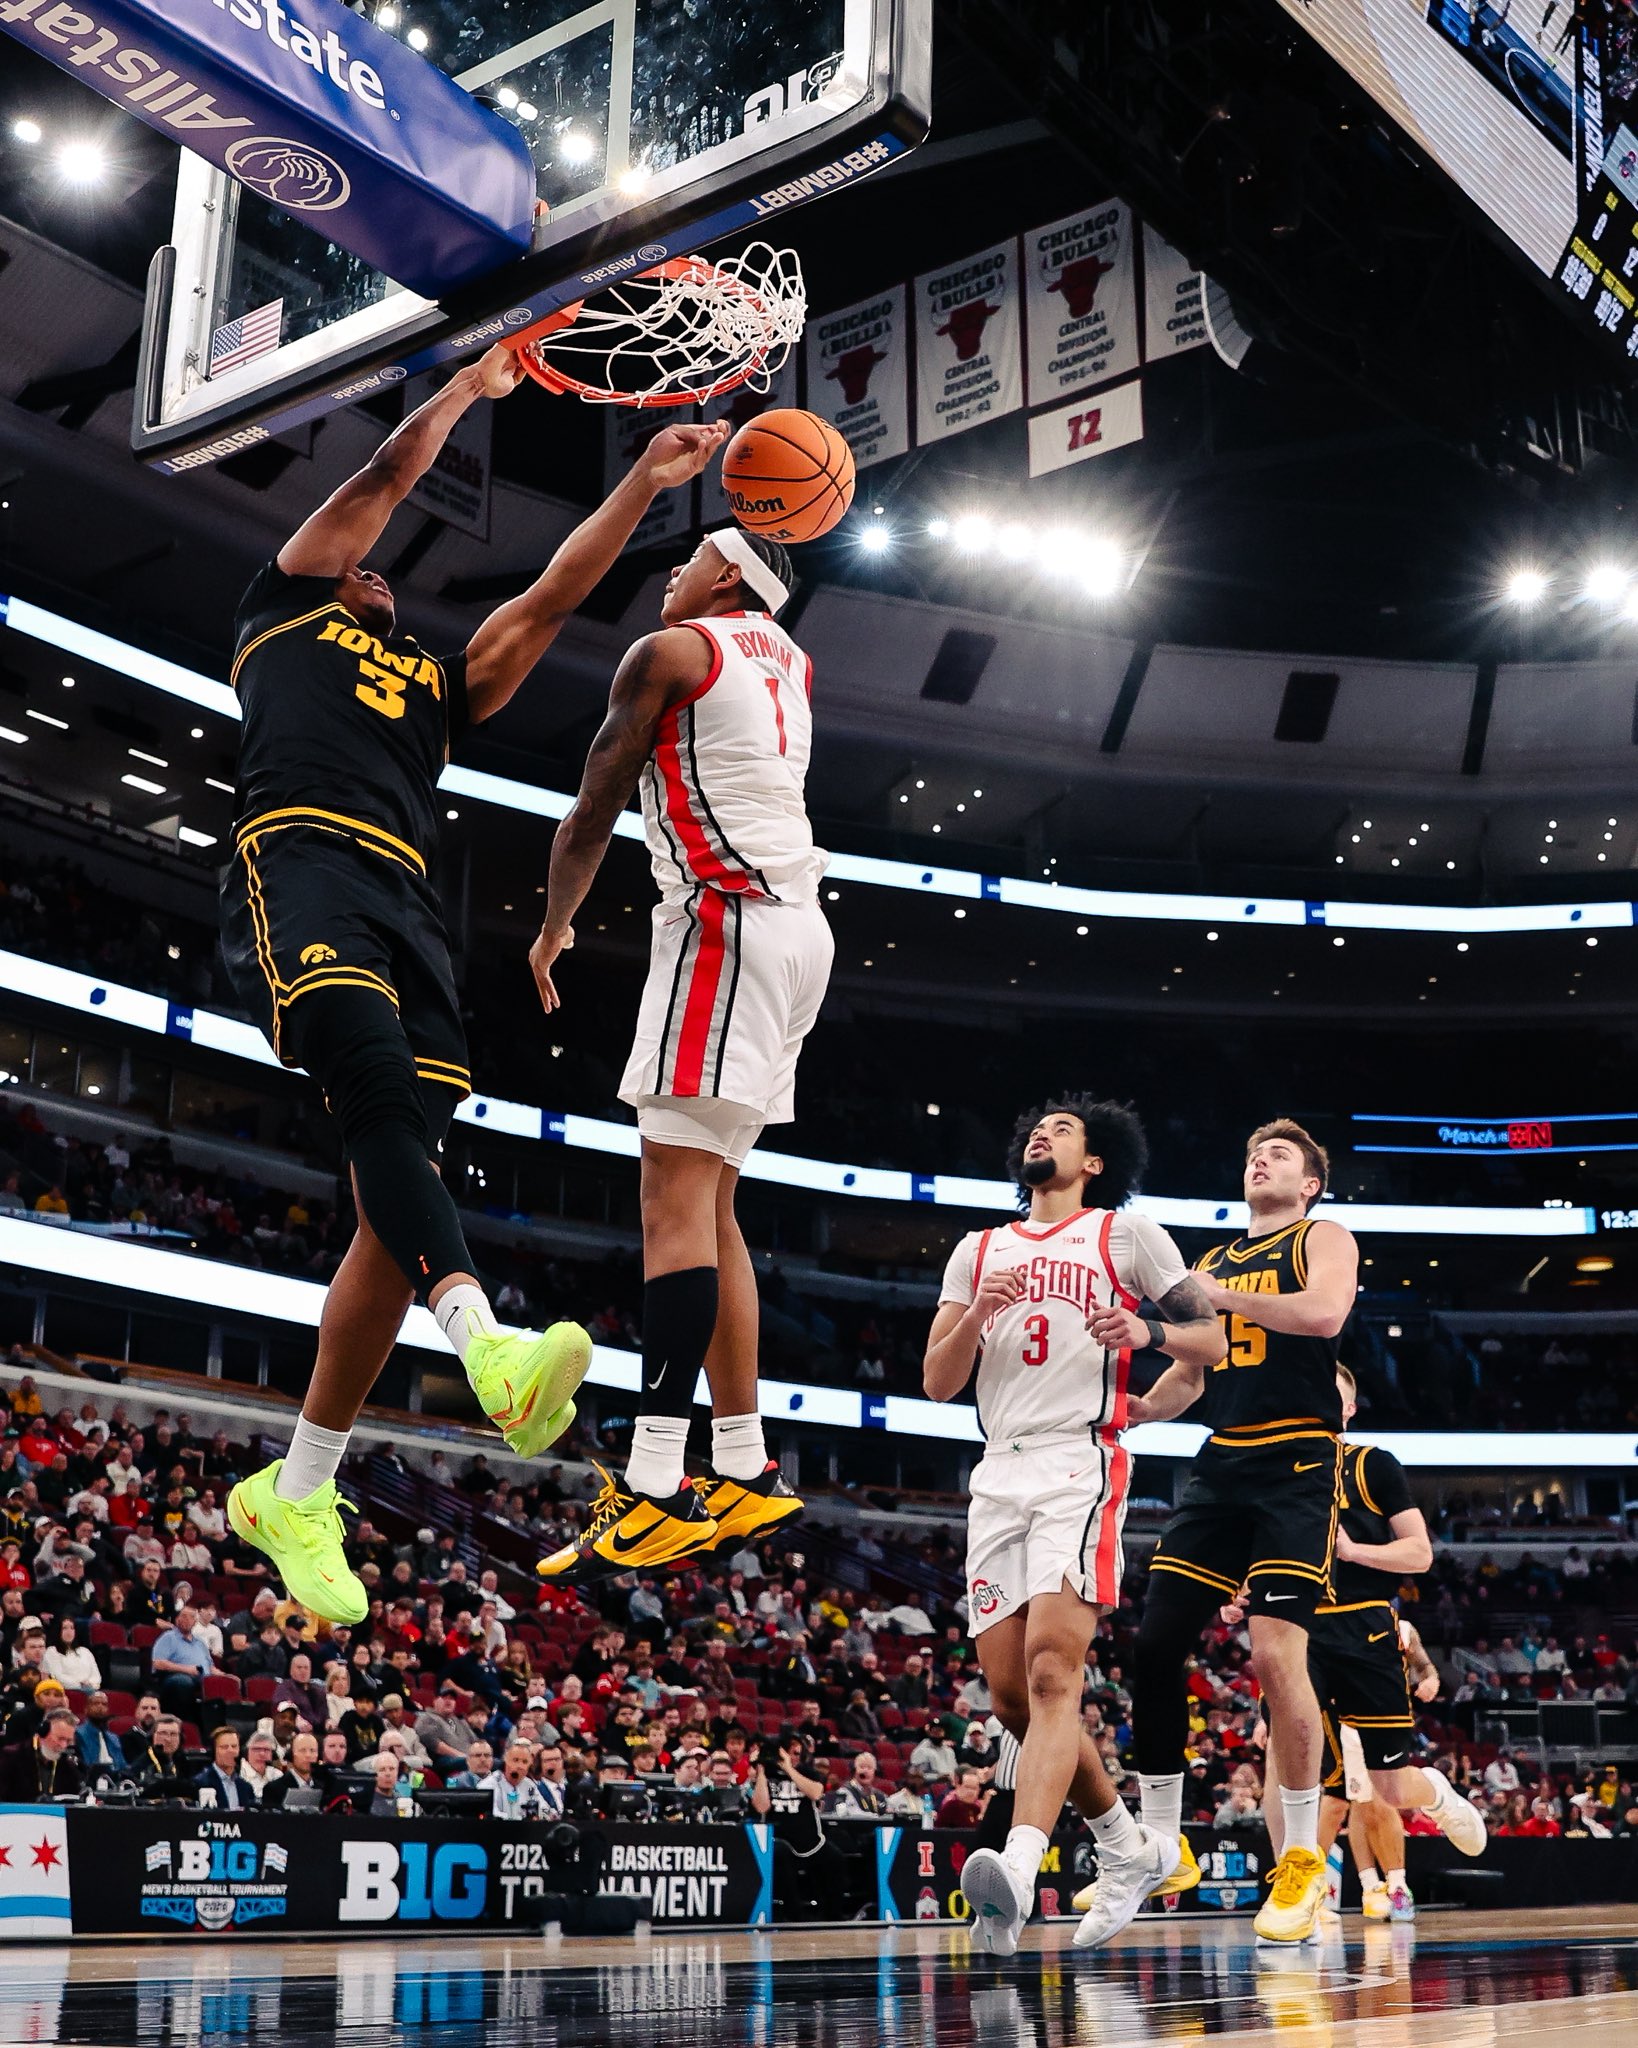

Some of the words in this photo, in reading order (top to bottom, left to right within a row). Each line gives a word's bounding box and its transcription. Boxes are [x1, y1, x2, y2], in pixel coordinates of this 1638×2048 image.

[213, 0, 386, 109] state
[749, 140, 890, 216] #B1GMBBT
[1037, 209, 1119, 252] CHICAGO
[1052, 231, 1108, 267] BULLS
[582, 255, 637, 284] Allstate
[928, 253, 1006, 296] CHICAGO
[941, 275, 996, 311] BULLS
[451, 319, 504, 347] Allstate
[818, 300, 892, 340] CHICAGO
[1058, 310, 1105, 337] CENTRAL
[830, 322, 883, 354] BULLS
[1048, 338, 1115, 373] CHAMPIONS
[1057, 325, 1107, 354] DIVISION
[944, 369, 993, 396] DIVISION
[945, 355, 990, 380] CENTRAL
[331, 374, 381, 400] Allstate
[935, 381, 1000, 413] CHAMPIONS
[835, 399, 877, 424] CENTRAL
[1067, 408, 1102, 451] 72
[316, 621, 441, 700] IOWA
[730, 631, 792, 677] BYNUM
[355, 659, 407, 719] 3
[765, 678, 786, 757] 1
[1029, 1256, 1098, 1319] STATE
[1022, 1314, 1049, 1366] 3
[212, 1822, 241, 1838] TIAA
[499, 1843, 549, 1870] 202
[610, 1845, 728, 1871] BASKETBALL
[142, 1884, 171, 1895] MEN'S
[172, 1884, 227, 1895] BASKETBALL
[229, 1884, 288, 1895] TOURNAMENT
